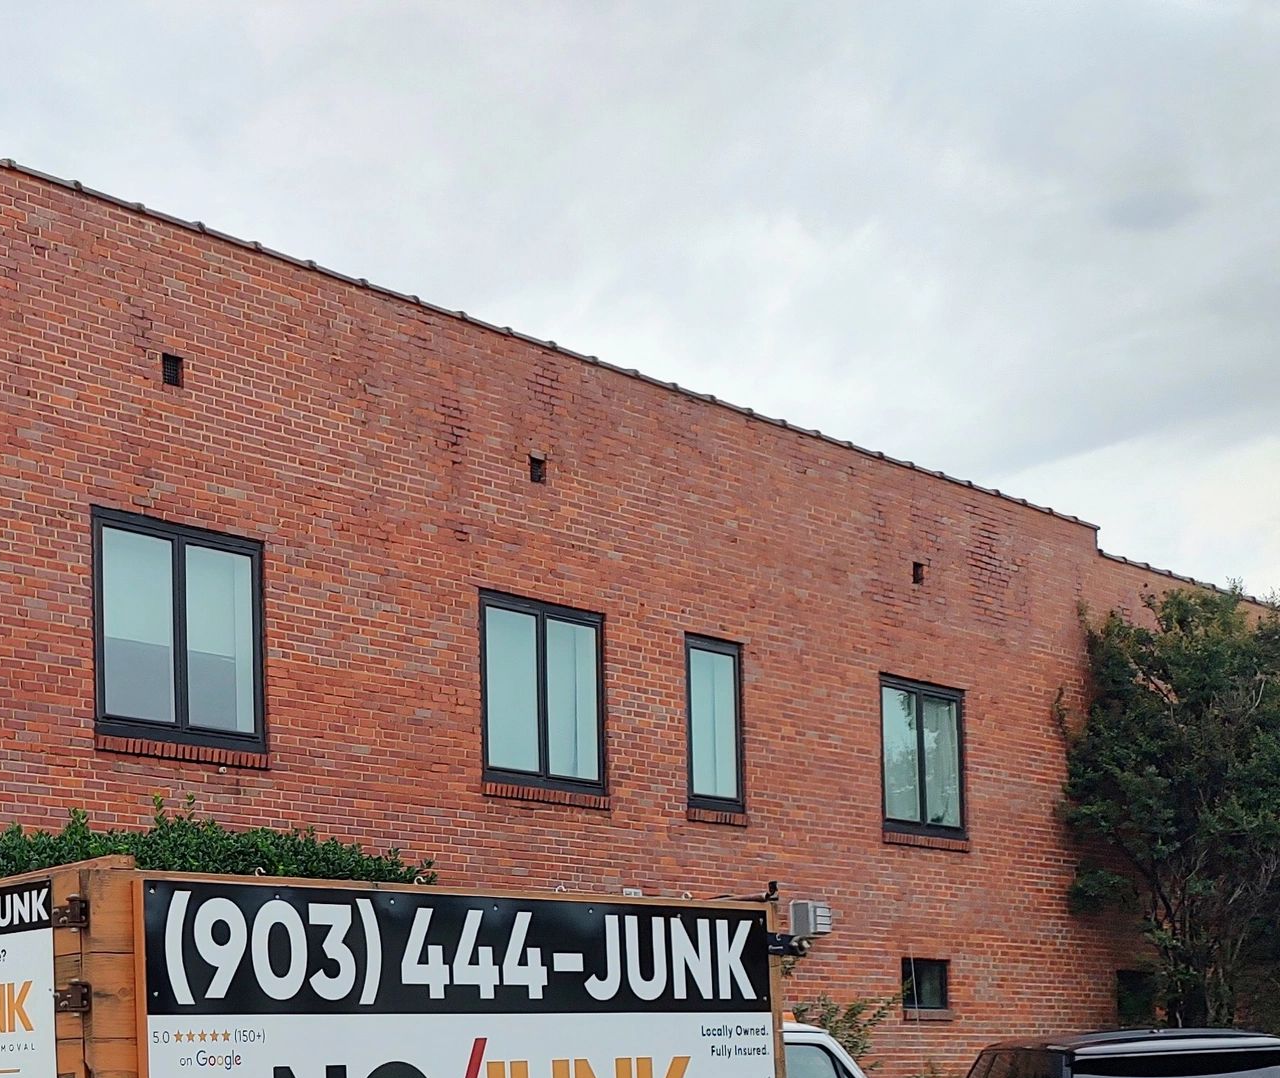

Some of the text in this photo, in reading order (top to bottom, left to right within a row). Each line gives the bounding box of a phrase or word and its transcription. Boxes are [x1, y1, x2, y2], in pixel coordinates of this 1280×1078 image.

[164, 889, 759, 1006] (903) 444-JUNK
[234, 1029, 266, 1044] (150+)
[701, 1025, 769, 1039] Locally Owned.
[711, 1045, 770, 1059] Fully Insured.
[179, 1050, 242, 1070] on Google
